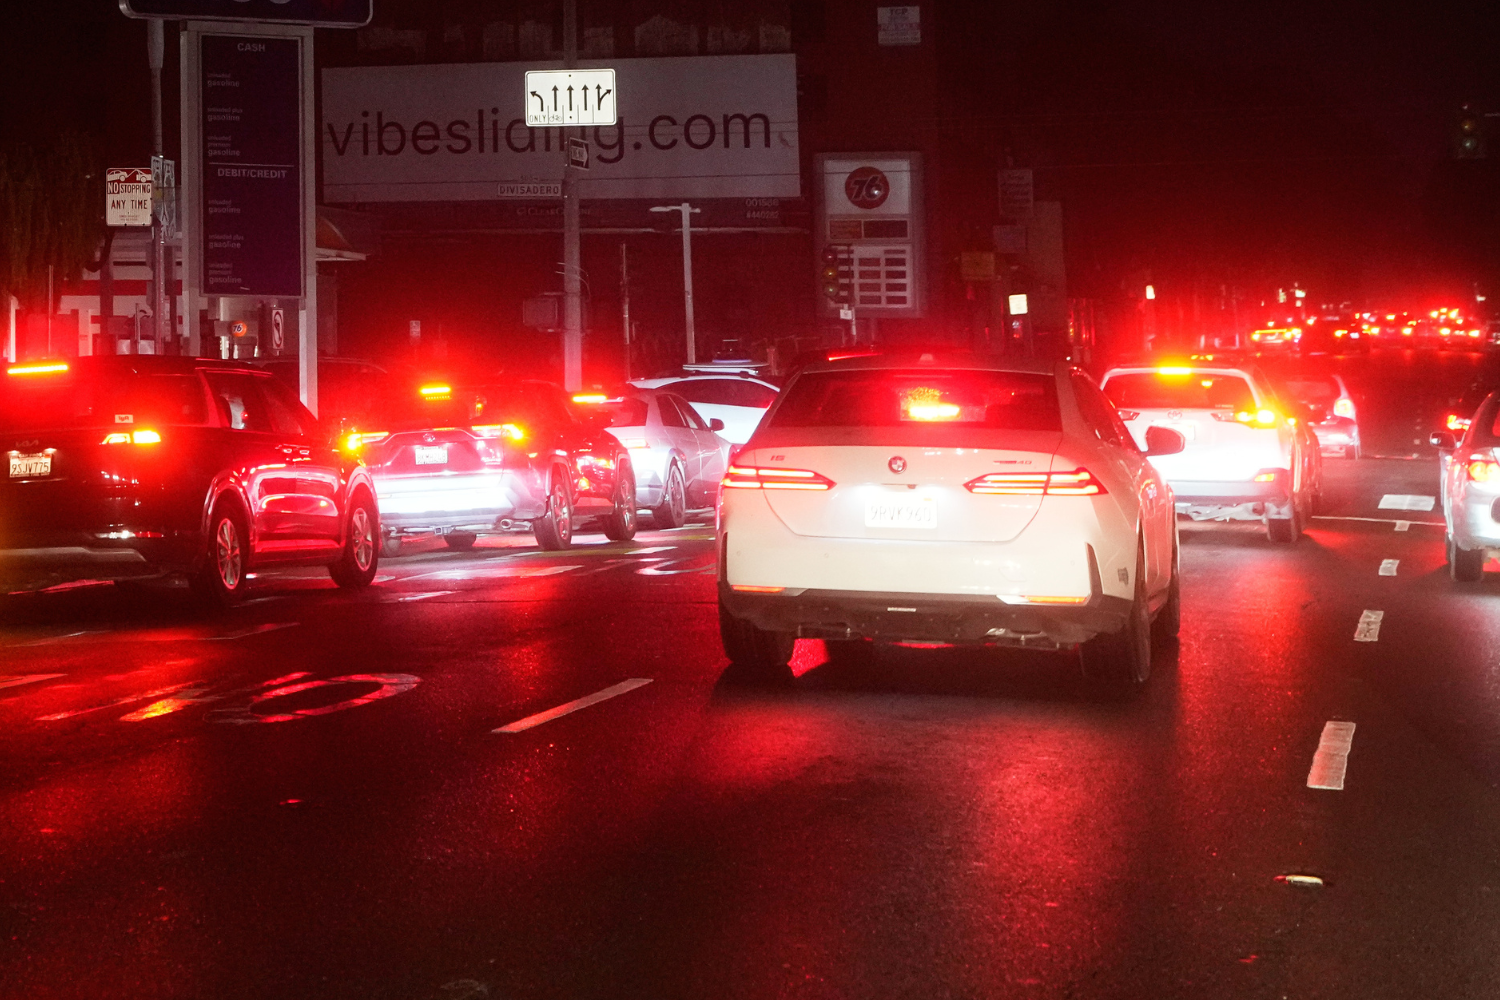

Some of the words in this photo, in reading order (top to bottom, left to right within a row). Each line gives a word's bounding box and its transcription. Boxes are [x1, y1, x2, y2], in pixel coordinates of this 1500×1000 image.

[237, 42, 266, 53] CASH
[207, 80, 240, 88] gasoline
[207, 114, 241, 122] gasoline
[208, 149, 241, 157] gasoline
[217, 168, 287, 179] DEBIT/CREDIT
[107, 181, 119, 193] NO
[120, 184, 151, 193] STOPPING
[498, 185, 560, 195] DIVISADERO
[850, 174, 884, 201] 76
[111, 200, 126, 210] ANY
[131, 200, 148, 210] TIME
[208, 207, 241, 215] gasoline
[209, 241, 241, 249] gasoline
[209, 275, 242, 284] gasoline
[232, 324, 243, 332] 76
[11, 462, 50, 474] 9SJV775
[870, 505, 931, 521] 9RVK960
